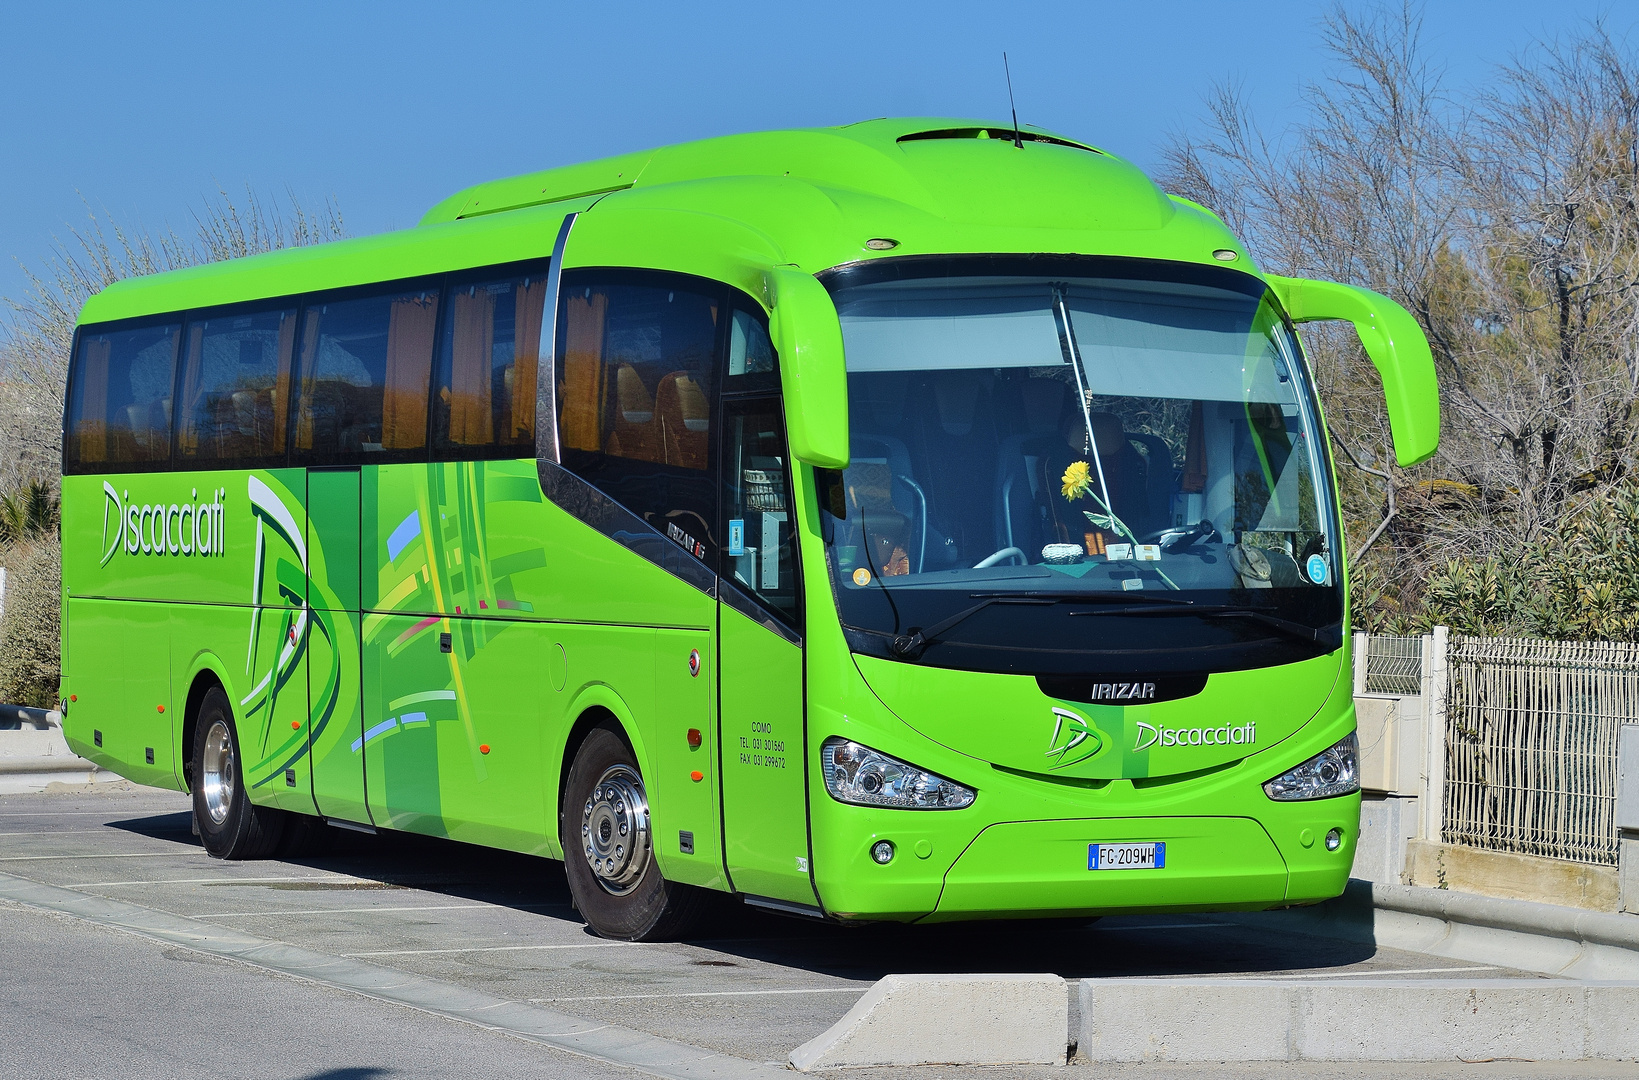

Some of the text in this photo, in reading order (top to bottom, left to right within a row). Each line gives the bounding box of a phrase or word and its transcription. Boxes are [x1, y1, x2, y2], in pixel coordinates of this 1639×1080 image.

[100, 480, 225, 569] Discacciati
[667, 521, 695, 553] IRIZAR
[1091, 682, 1156, 700] IRIZAR
[752, 721, 772, 734] COMO
[740, 736, 785, 752] TEL. 031 301560
[1133, 721, 1256, 753] Discacciati
[754, 754, 763, 766] 031
[765, 755, 786, 769] 299672
